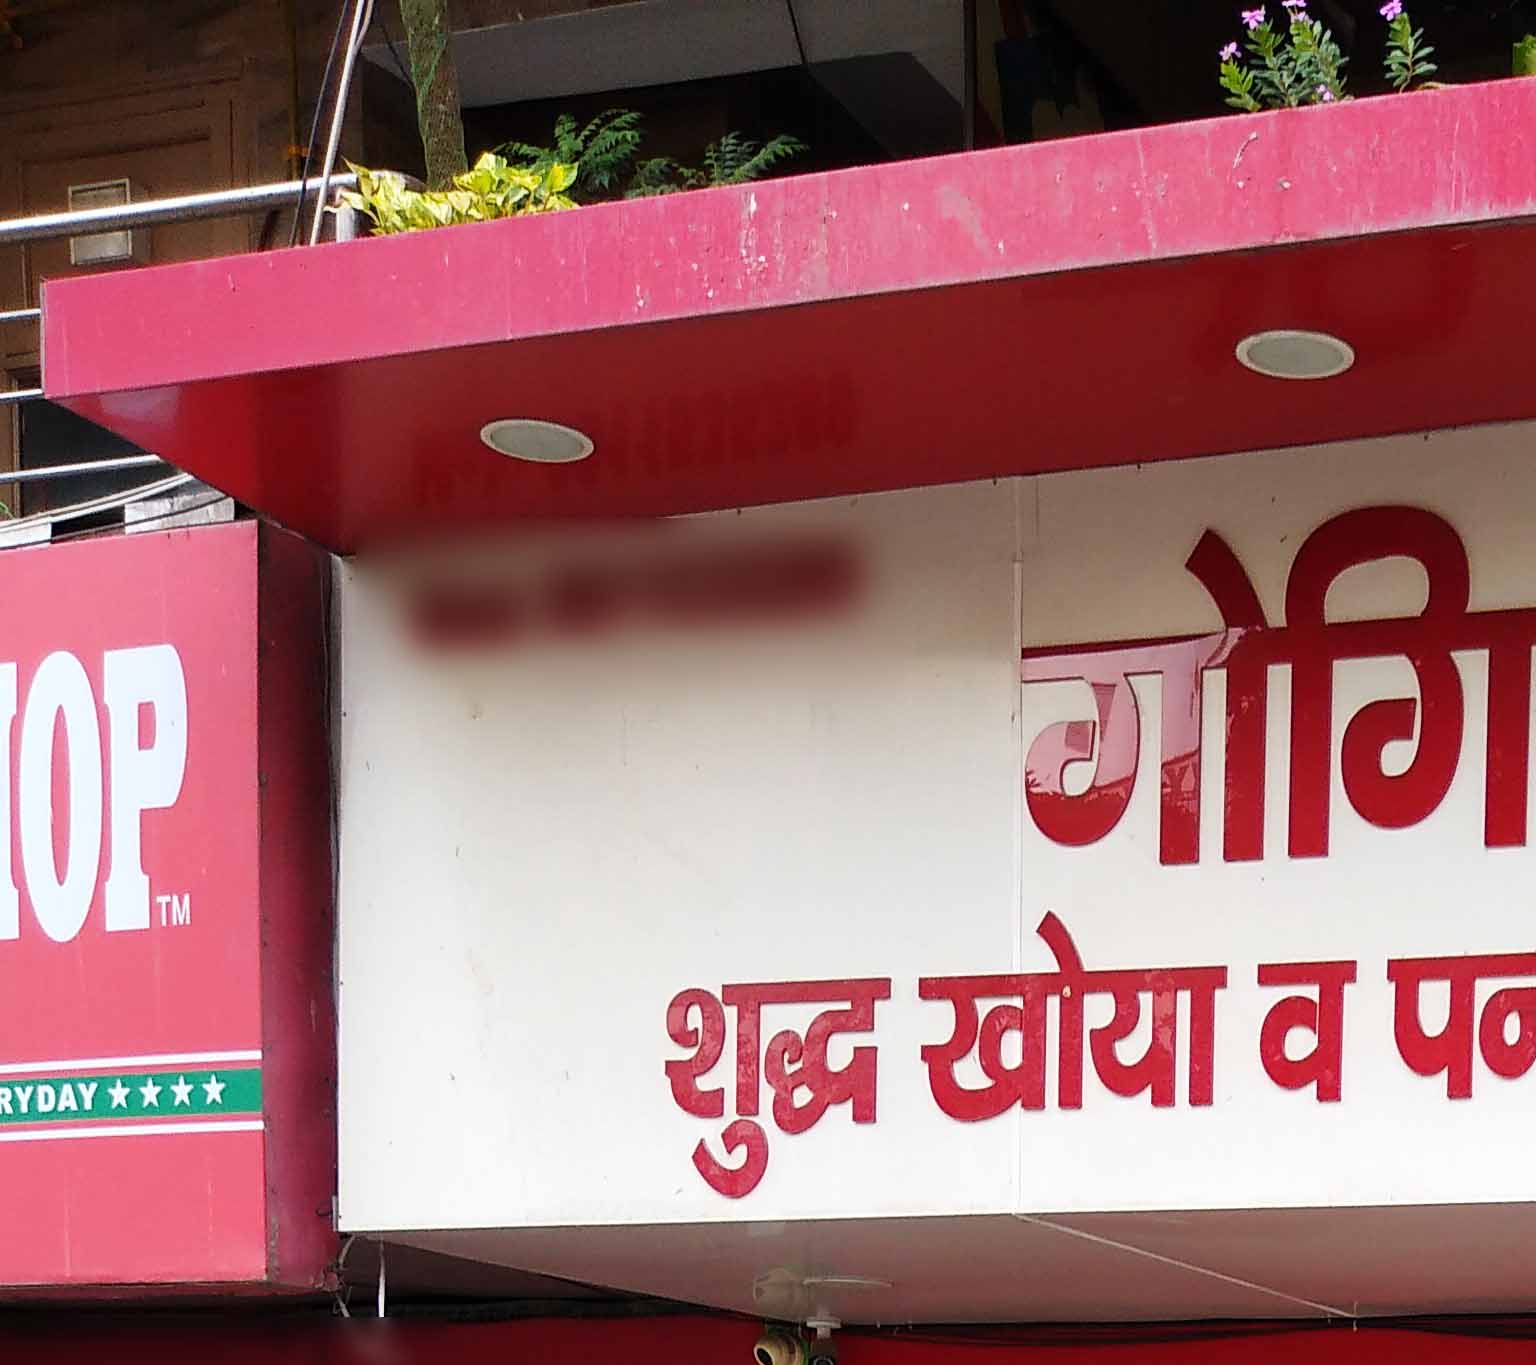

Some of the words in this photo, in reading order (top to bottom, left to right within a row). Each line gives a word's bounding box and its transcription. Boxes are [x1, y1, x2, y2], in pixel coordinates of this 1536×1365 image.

[156, 894, 191, 927] TM
[665, 978, 892, 1199] शुद्ध
[918, 911, 1227, 1121] खोया
[1258, 959, 1357, 1102] व
